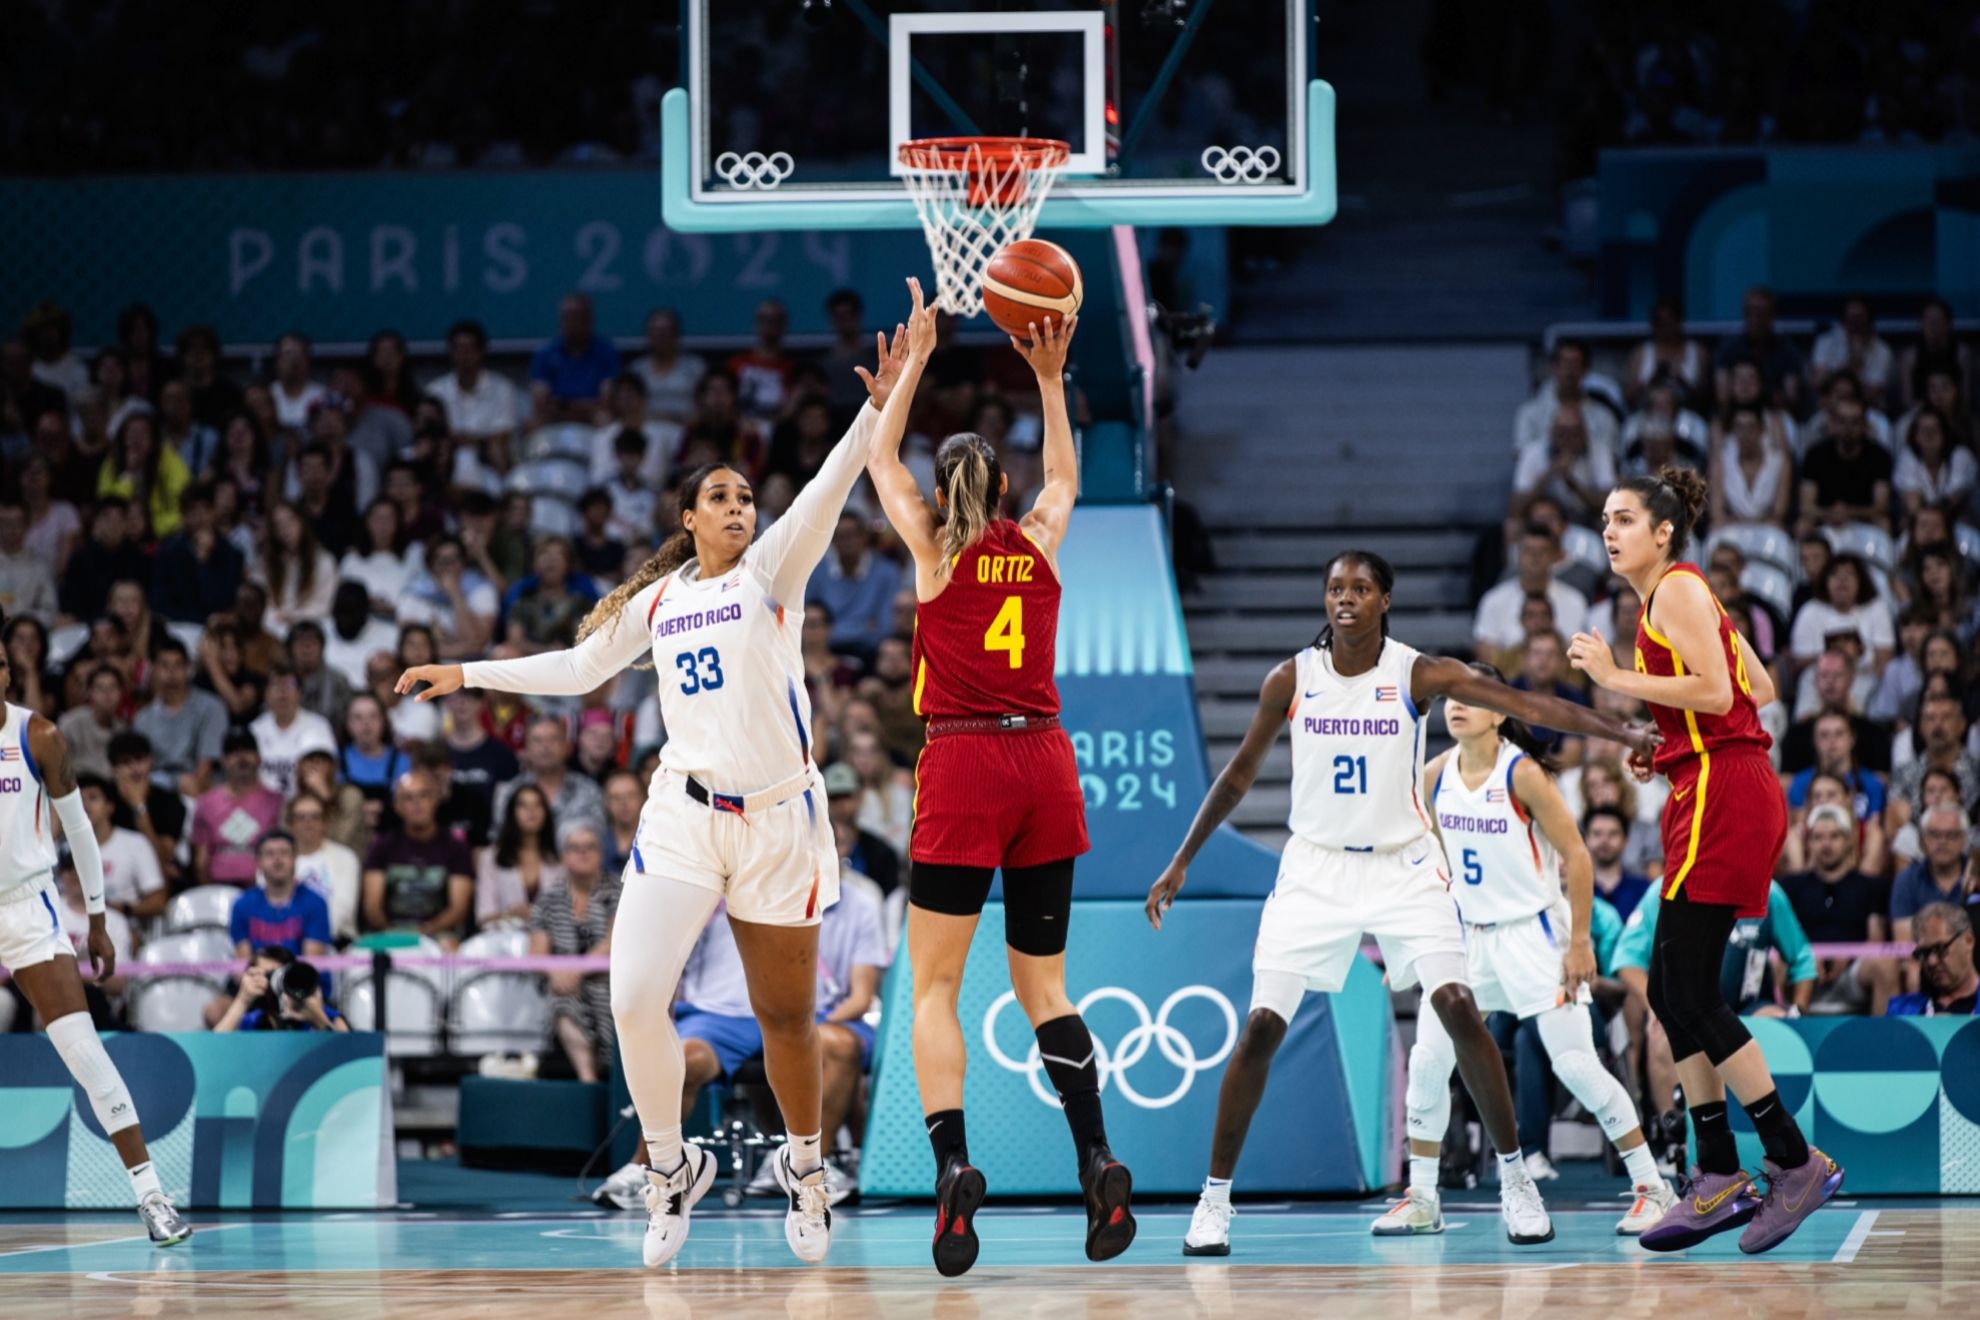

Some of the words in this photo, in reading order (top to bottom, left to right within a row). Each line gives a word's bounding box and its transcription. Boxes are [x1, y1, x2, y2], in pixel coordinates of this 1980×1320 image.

[230, 222, 528, 294] PARIS
[574, 220, 850, 290] 2024
[977, 554, 1035, 583] ORTIZ
[656, 611, 704, 640] PUERTO
[706, 602, 742, 627] RICO
[984, 595, 1026, 670] 4
[675, 645, 725, 696] 33
[1304, 716, 1361, 736] PUERTO
[1362, 718, 1399, 736] RICO
[1071, 728, 1175, 769] ARIS
[0, 777, 22, 793] ICO
[1079, 772, 1177, 811] 024
[1332, 755, 1367, 795] 21
[1439, 812, 1475, 833] UERTO
[1476, 817, 1509, 835] RICO
[1462, 847, 1483, 886] 5
